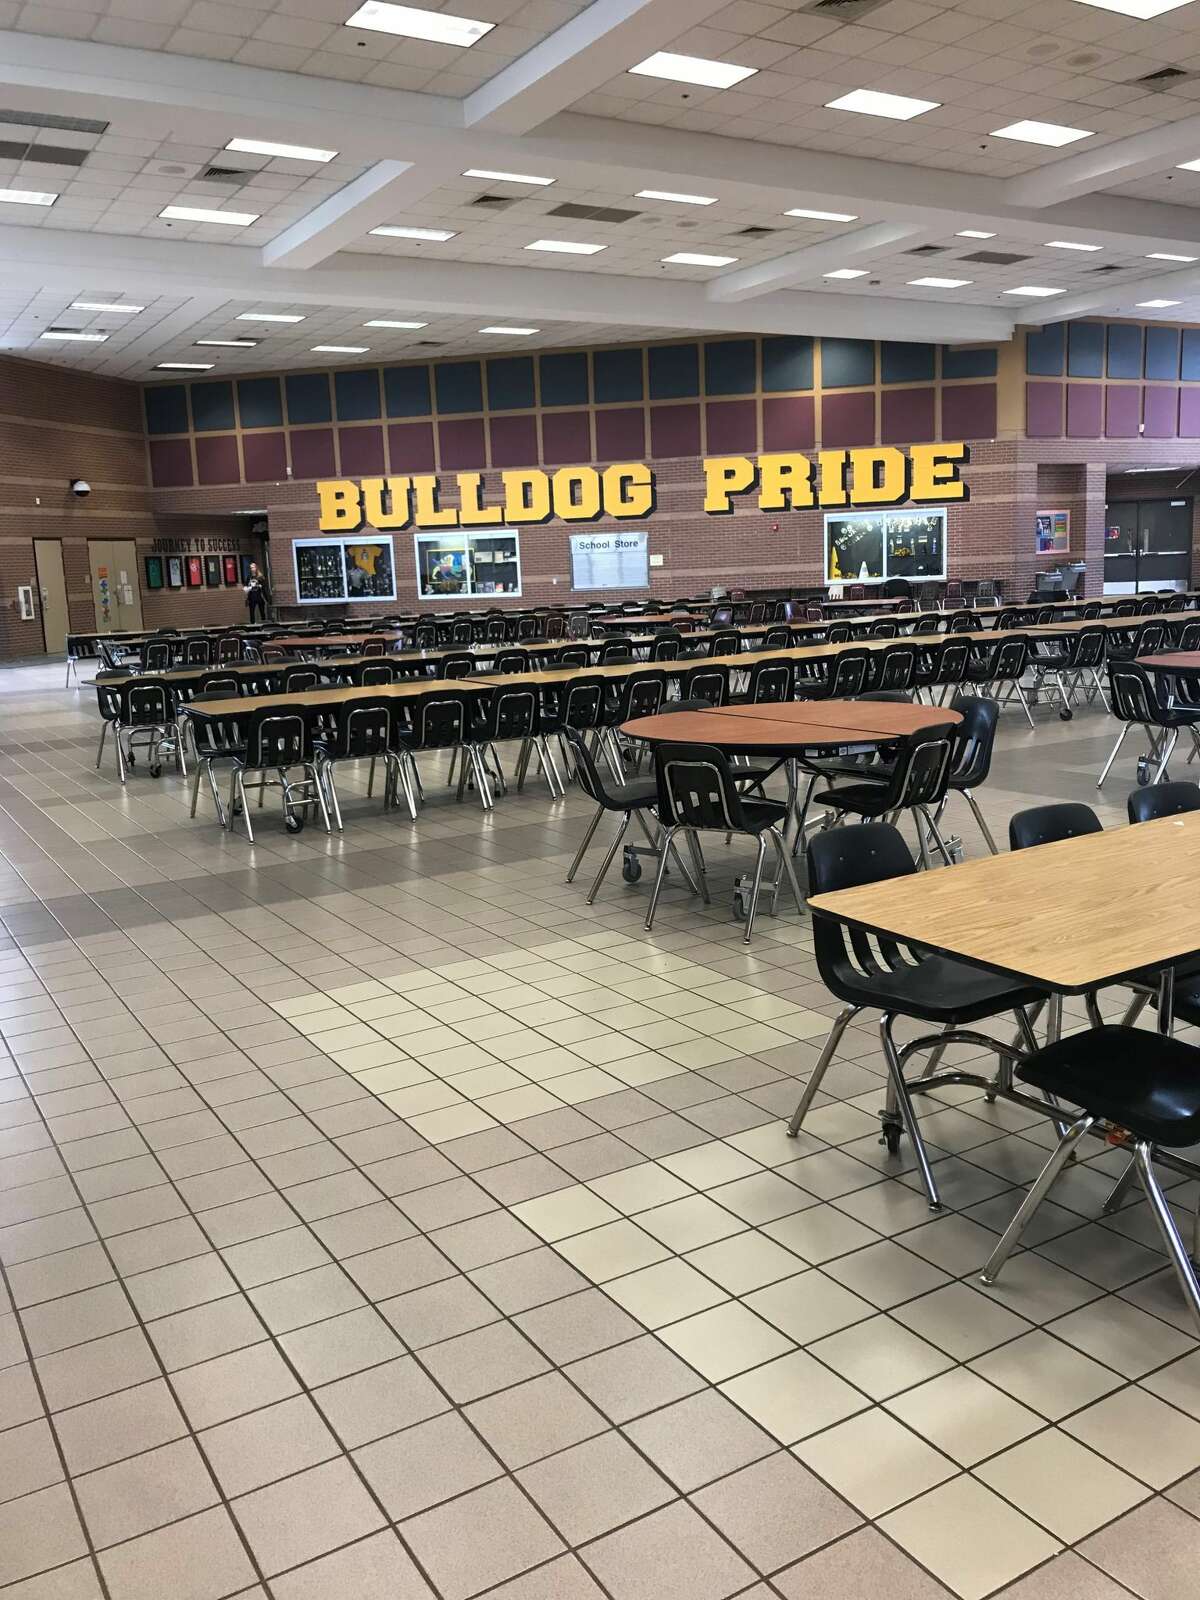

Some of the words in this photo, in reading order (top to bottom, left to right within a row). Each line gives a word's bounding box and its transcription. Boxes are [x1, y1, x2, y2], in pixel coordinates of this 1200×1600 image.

[316, 463, 655, 533] BULLDOG
[703, 443, 970, 515] PRIDE
[194, 537, 206, 553] TO
[579, 541, 610, 550] School
[614, 539, 639, 549] Store
